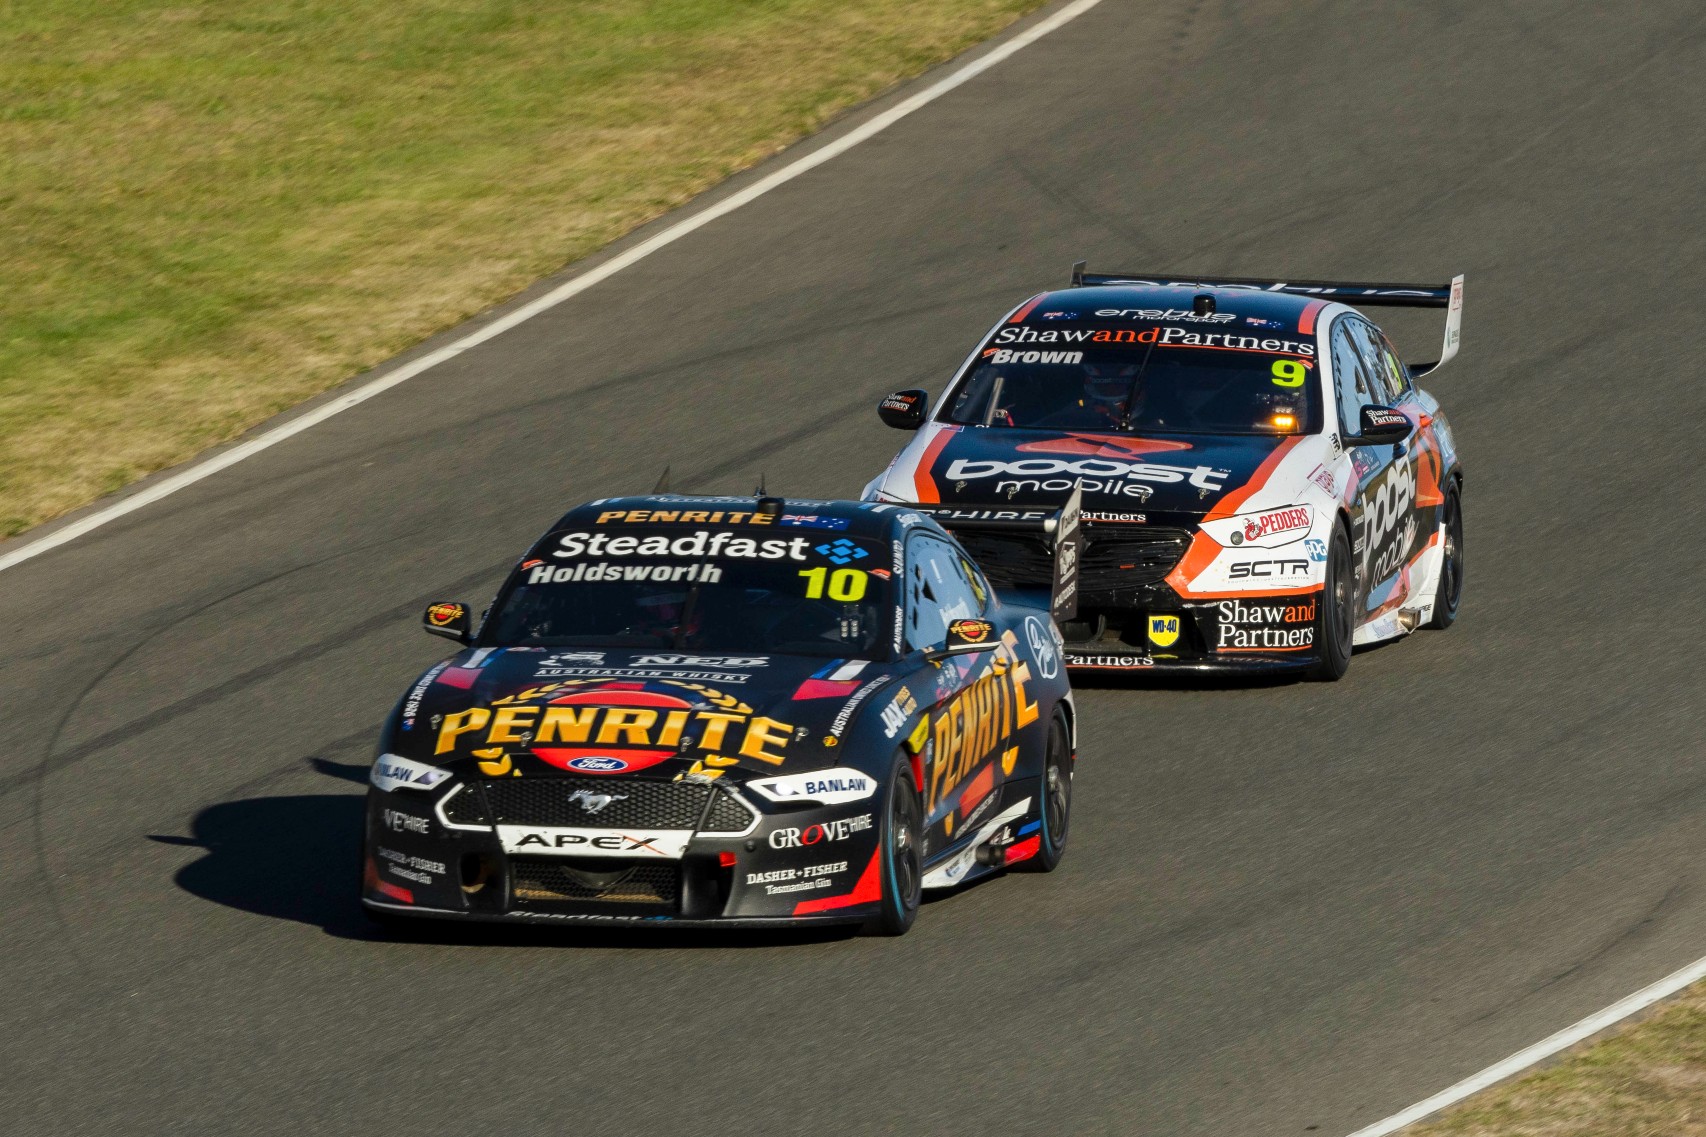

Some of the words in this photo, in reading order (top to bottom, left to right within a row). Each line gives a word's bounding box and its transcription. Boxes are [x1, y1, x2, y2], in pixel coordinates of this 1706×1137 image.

[990, 349, 1084, 364] Brown
[1271, 359, 1306, 388] 9
[945, 458, 1230, 491] boost
[994, 477, 1154, 497] mobile
[595, 509, 777, 526] PENRITE
[1258, 507, 1310, 535] PEDDERS
[552, 531, 810, 561] Steadfast
[527, 562, 723, 586] Holdsworth
[1228, 559, 1310, 579] SCTR
[797, 566, 869, 602] 10
[1152, 618, 1178, 634] WD-40
[1217, 623, 1314, 648] Partners
[535, 667, 662, 677] AUSTRALIAN
[671, 671, 750, 682] WHISKY
[434, 704, 794, 767] PENRITE
[929, 661, 1040, 818] PENRITE
[575, 756, 617, 770] Ford
[804, 778, 867, 795] BANLAW
[515, 832, 668, 856] APEX
[768, 820, 850, 849] GROVE
